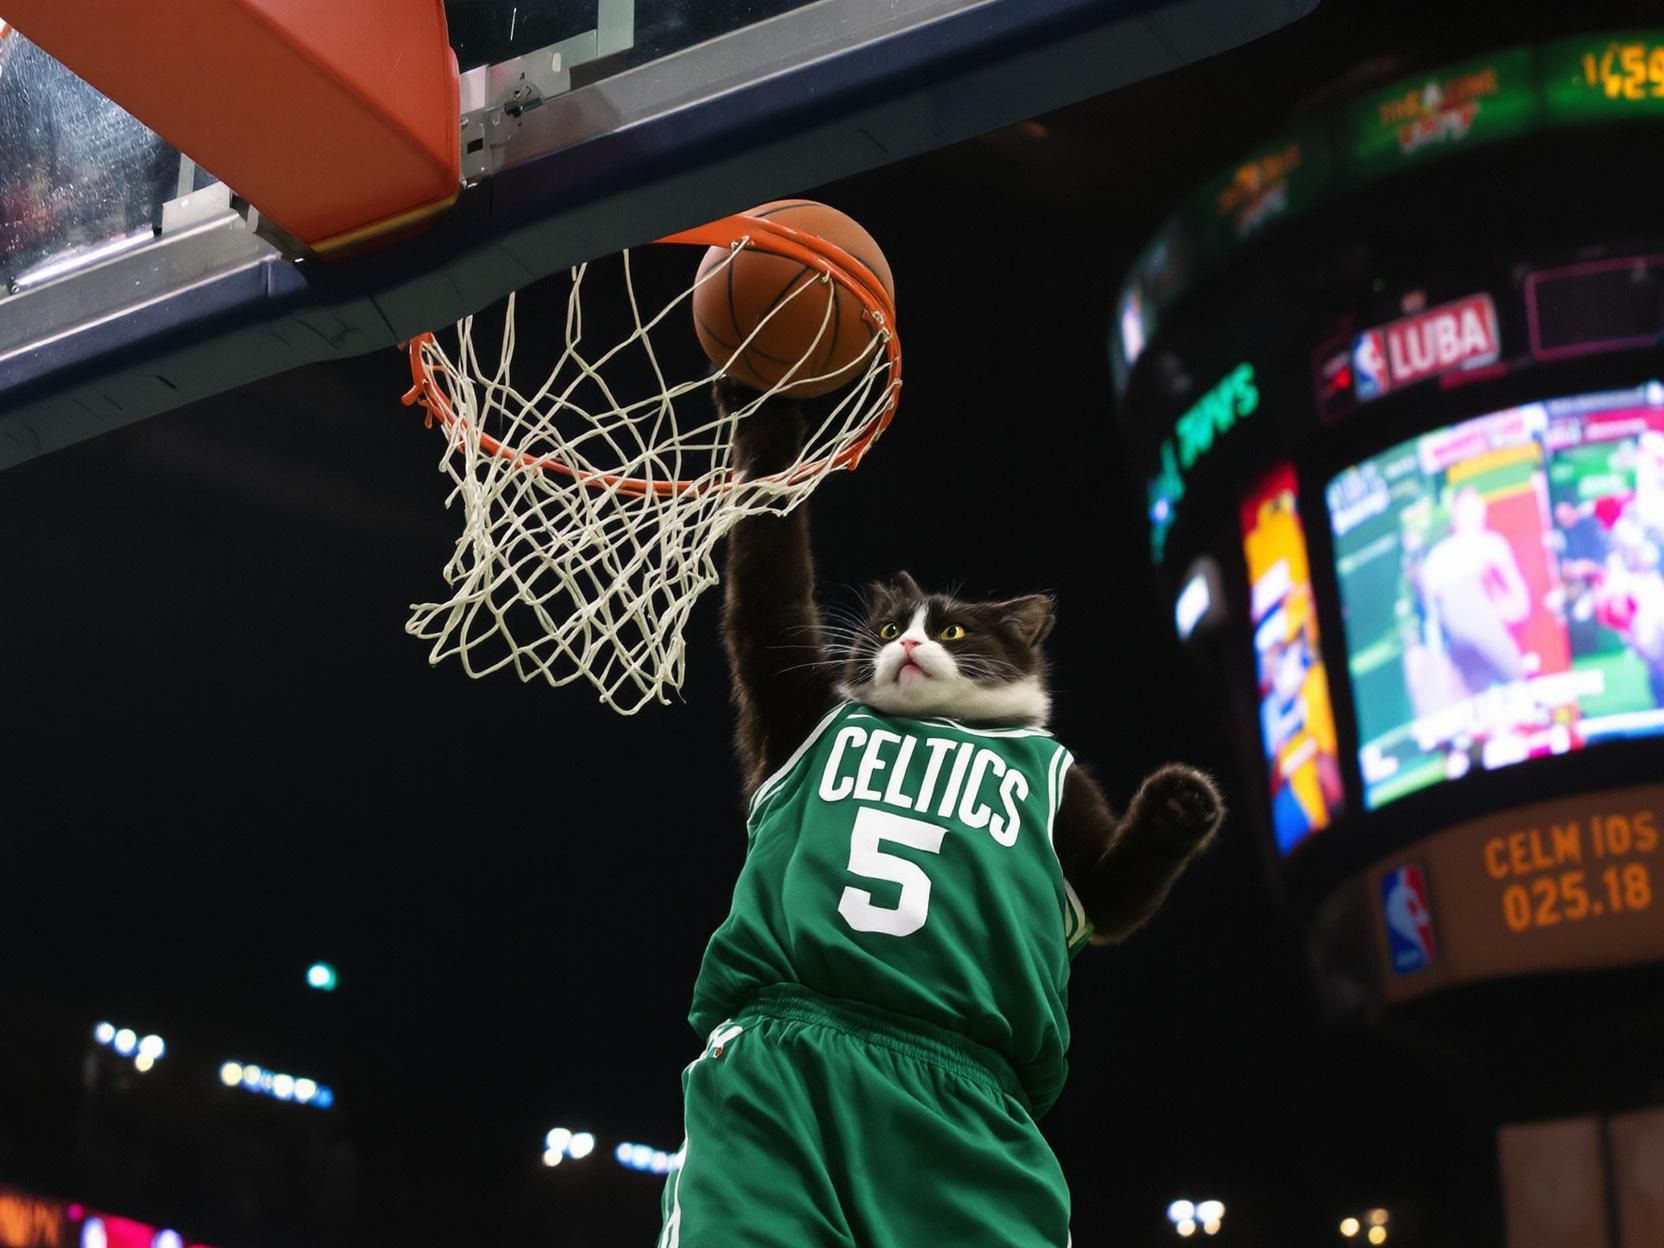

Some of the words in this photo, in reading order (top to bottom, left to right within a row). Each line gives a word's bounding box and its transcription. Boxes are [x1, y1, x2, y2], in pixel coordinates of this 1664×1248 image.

[1388, 307, 1489, 380] LUBA
[818, 726, 1029, 848] CELTICS
[838, 806, 951, 938] 5
[1502, 861, 1653, 934] 025.18
